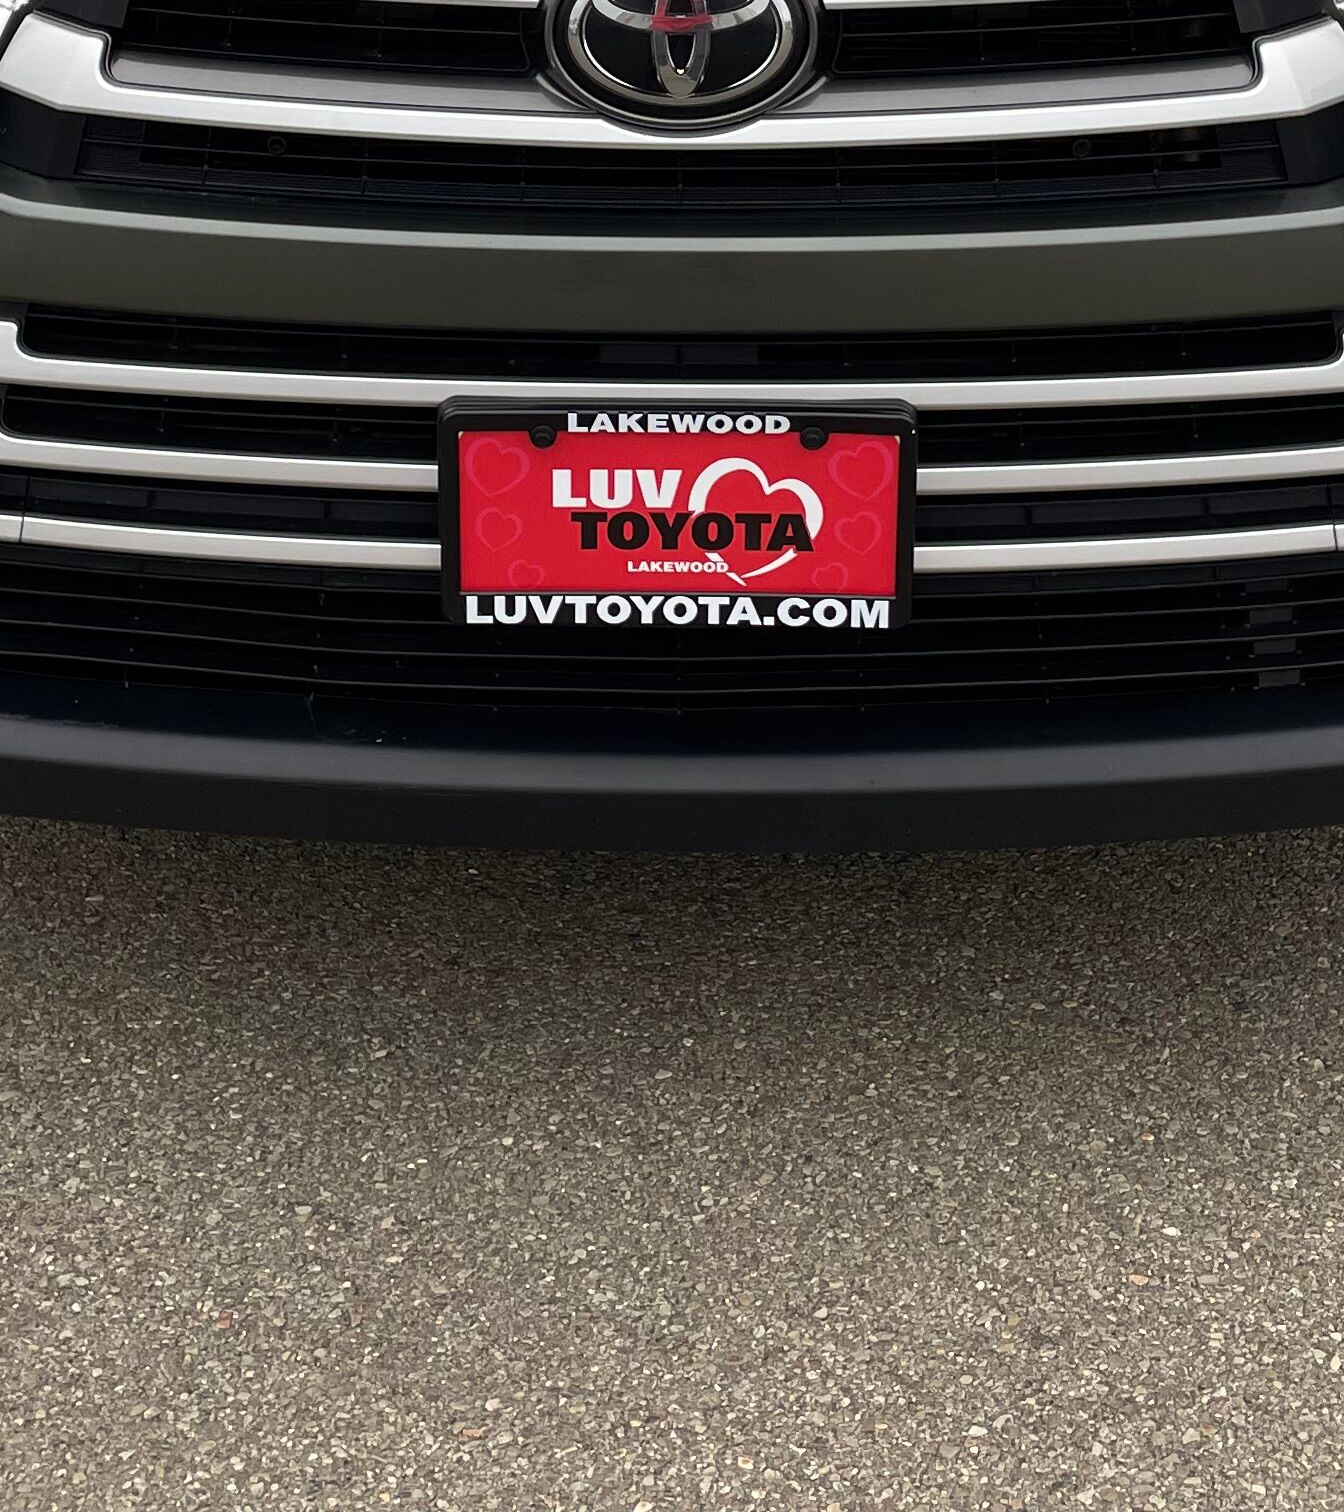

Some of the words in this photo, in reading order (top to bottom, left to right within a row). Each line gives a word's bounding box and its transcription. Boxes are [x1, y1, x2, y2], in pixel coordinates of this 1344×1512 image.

[567, 412, 792, 436] LAKEWOOD
[551, 468, 684, 509] LUV
[570, 511, 815, 553] TOYOTA
[626, 559, 730, 575] LAKEWOOD
[464, 595, 892, 630] LUVTOYOTA.COM
